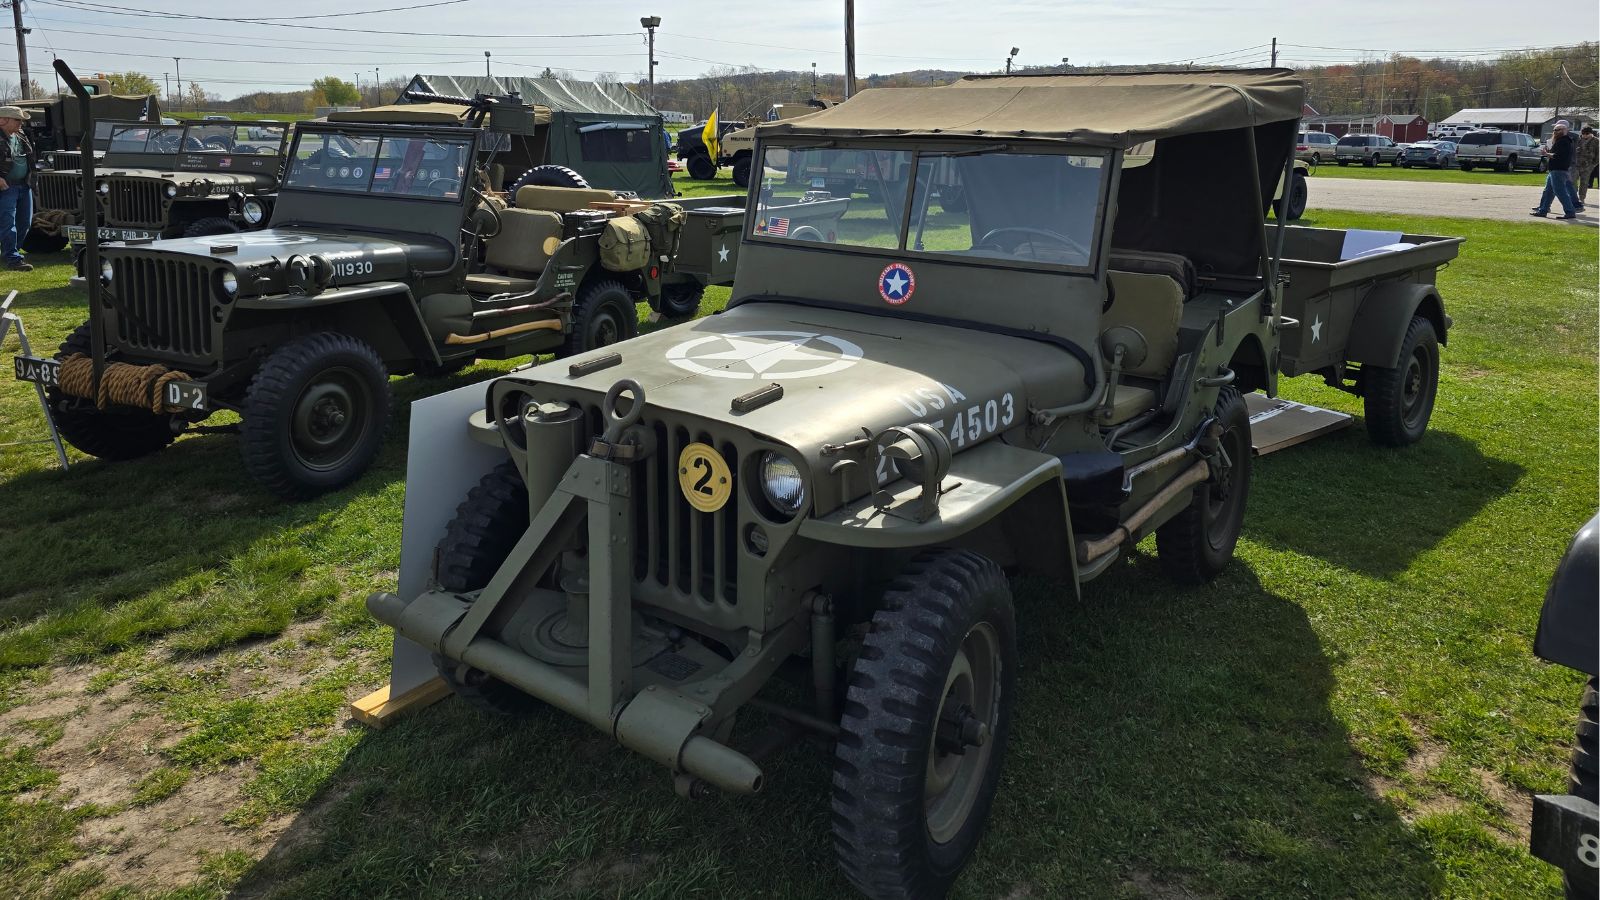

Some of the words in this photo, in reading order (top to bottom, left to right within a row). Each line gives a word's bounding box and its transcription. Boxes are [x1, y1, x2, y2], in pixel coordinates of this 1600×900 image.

[169, 383, 204, 410] D-2
[896, 381, 966, 418] USA
[693, 456, 713, 496] 2
